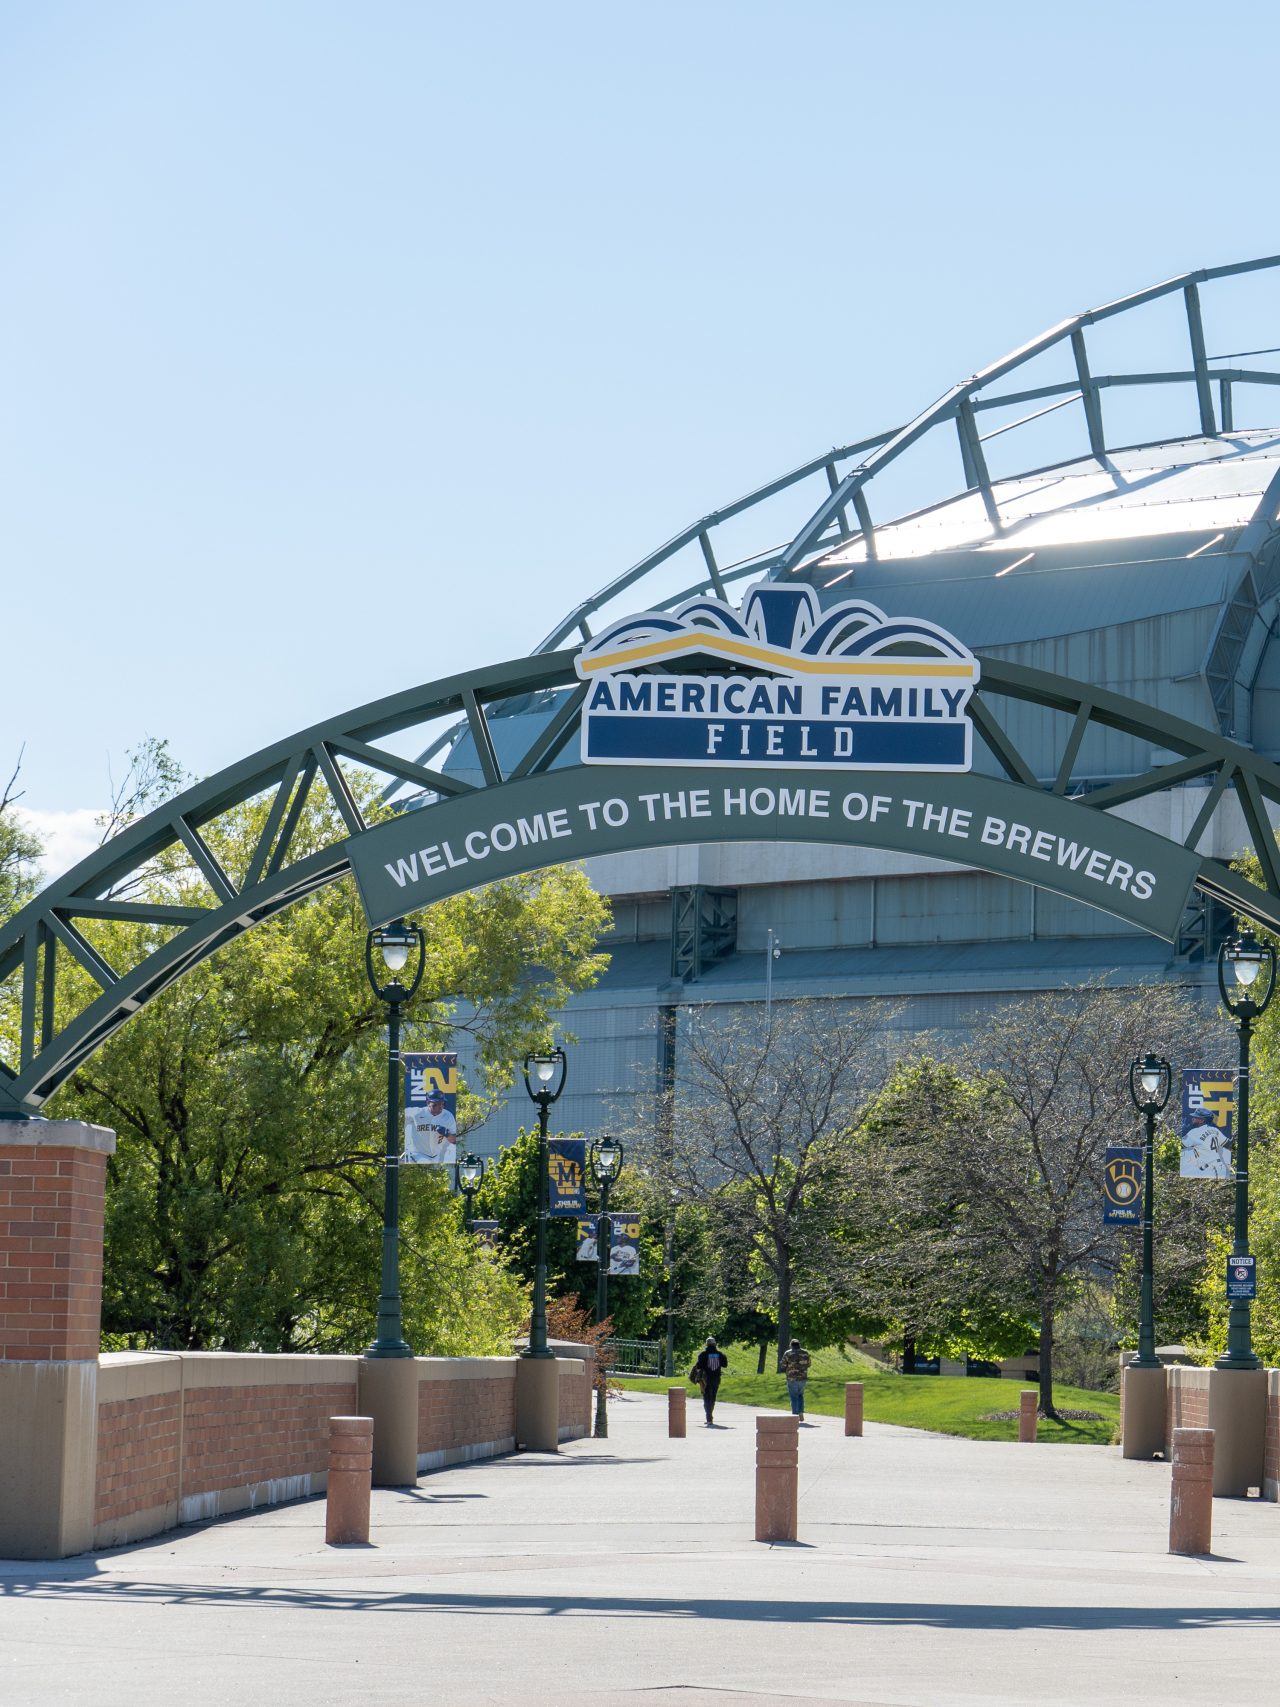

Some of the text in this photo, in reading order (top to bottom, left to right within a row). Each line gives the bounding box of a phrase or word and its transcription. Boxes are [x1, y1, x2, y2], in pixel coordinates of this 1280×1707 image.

[589, 680, 966, 718] AMERICAN FAMILY
[706, 724, 854, 757] FIELD
[384, 788, 1157, 900] WELCOME TO THE HOME OF THE BREWERS
[410, 1068, 427, 1101] INF
[422, 1067, 457, 1094] 2
[1188, 1083, 1204, 1109] OF
[1200, 1081, 1234, 1128] 41
